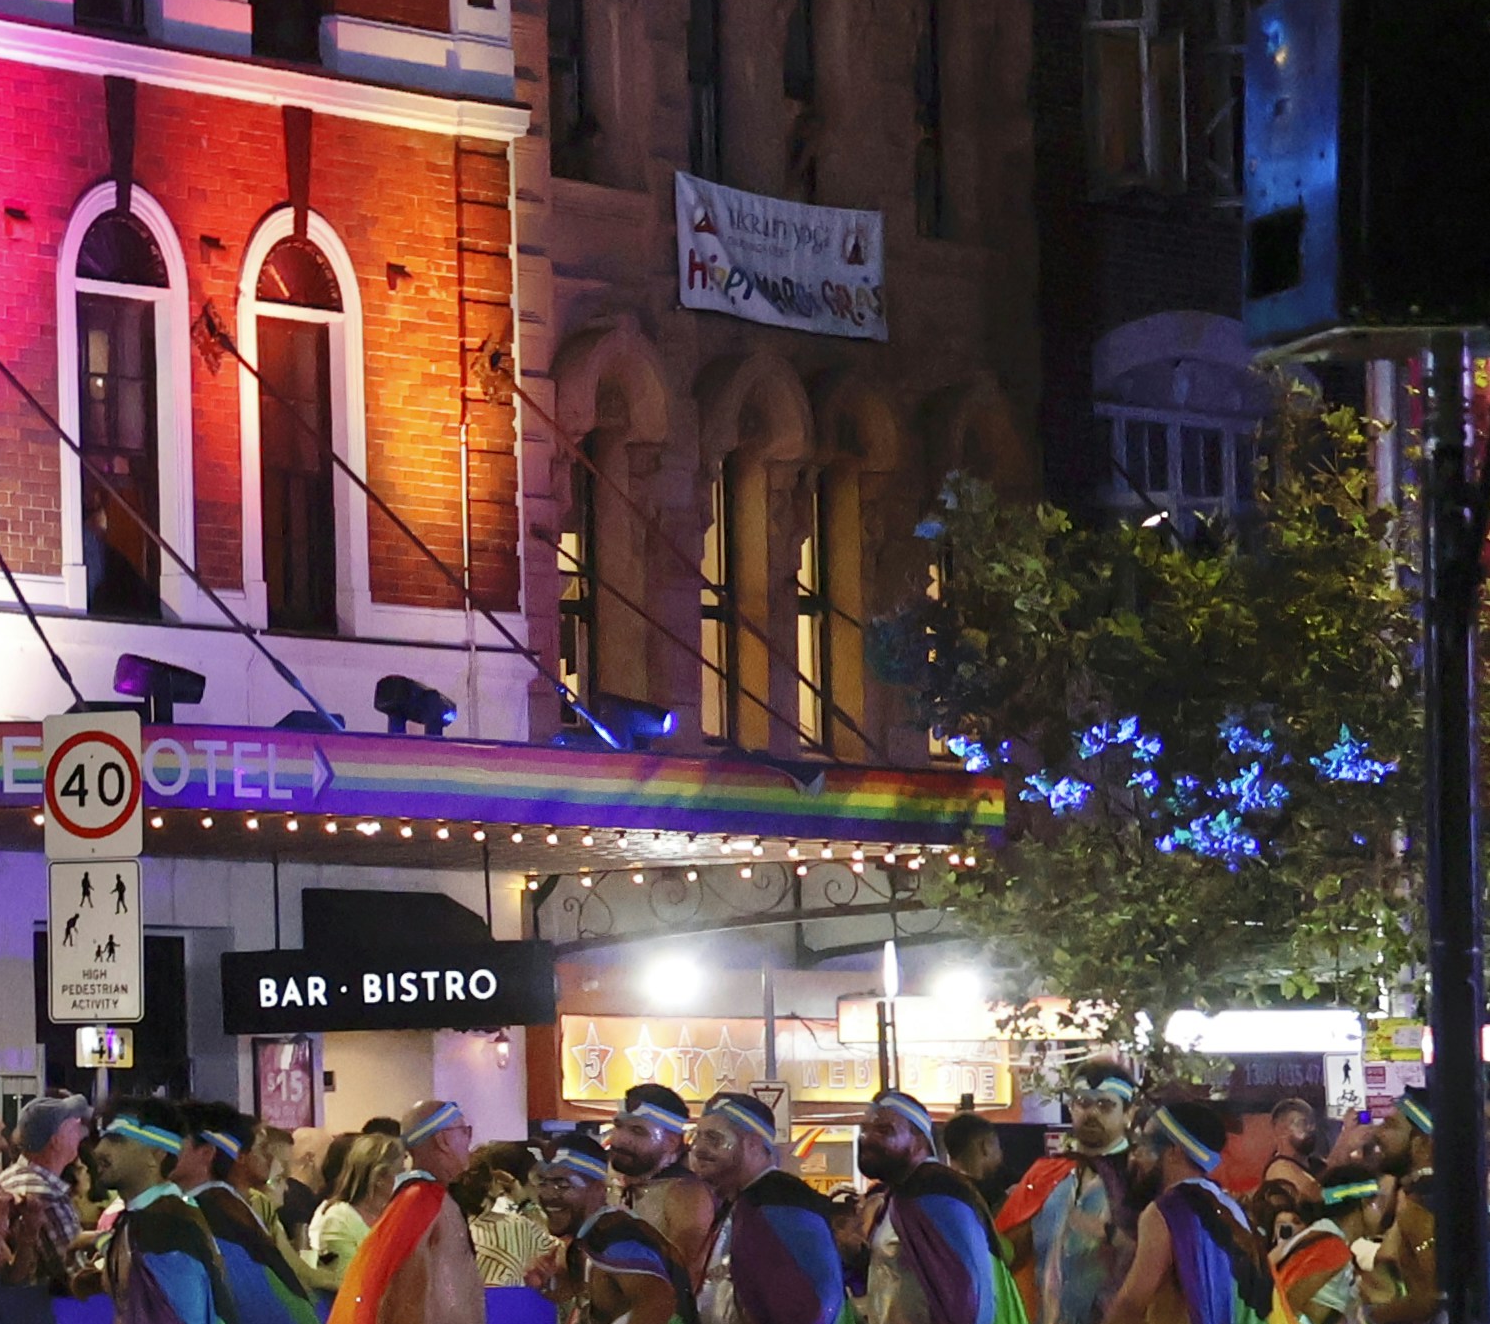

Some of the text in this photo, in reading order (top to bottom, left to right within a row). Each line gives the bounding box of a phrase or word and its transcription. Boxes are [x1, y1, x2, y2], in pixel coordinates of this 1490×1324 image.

[143, 737, 293, 800] OTEL
[60, 761, 125, 807] 40
[82, 968, 108, 980] HIGH
[61, 983, 129, 996] PEDESTRIAN
[259, 968, 498, 1008] BAR BISTRO
[70, 998, 120, 1011] ACTIVITY
